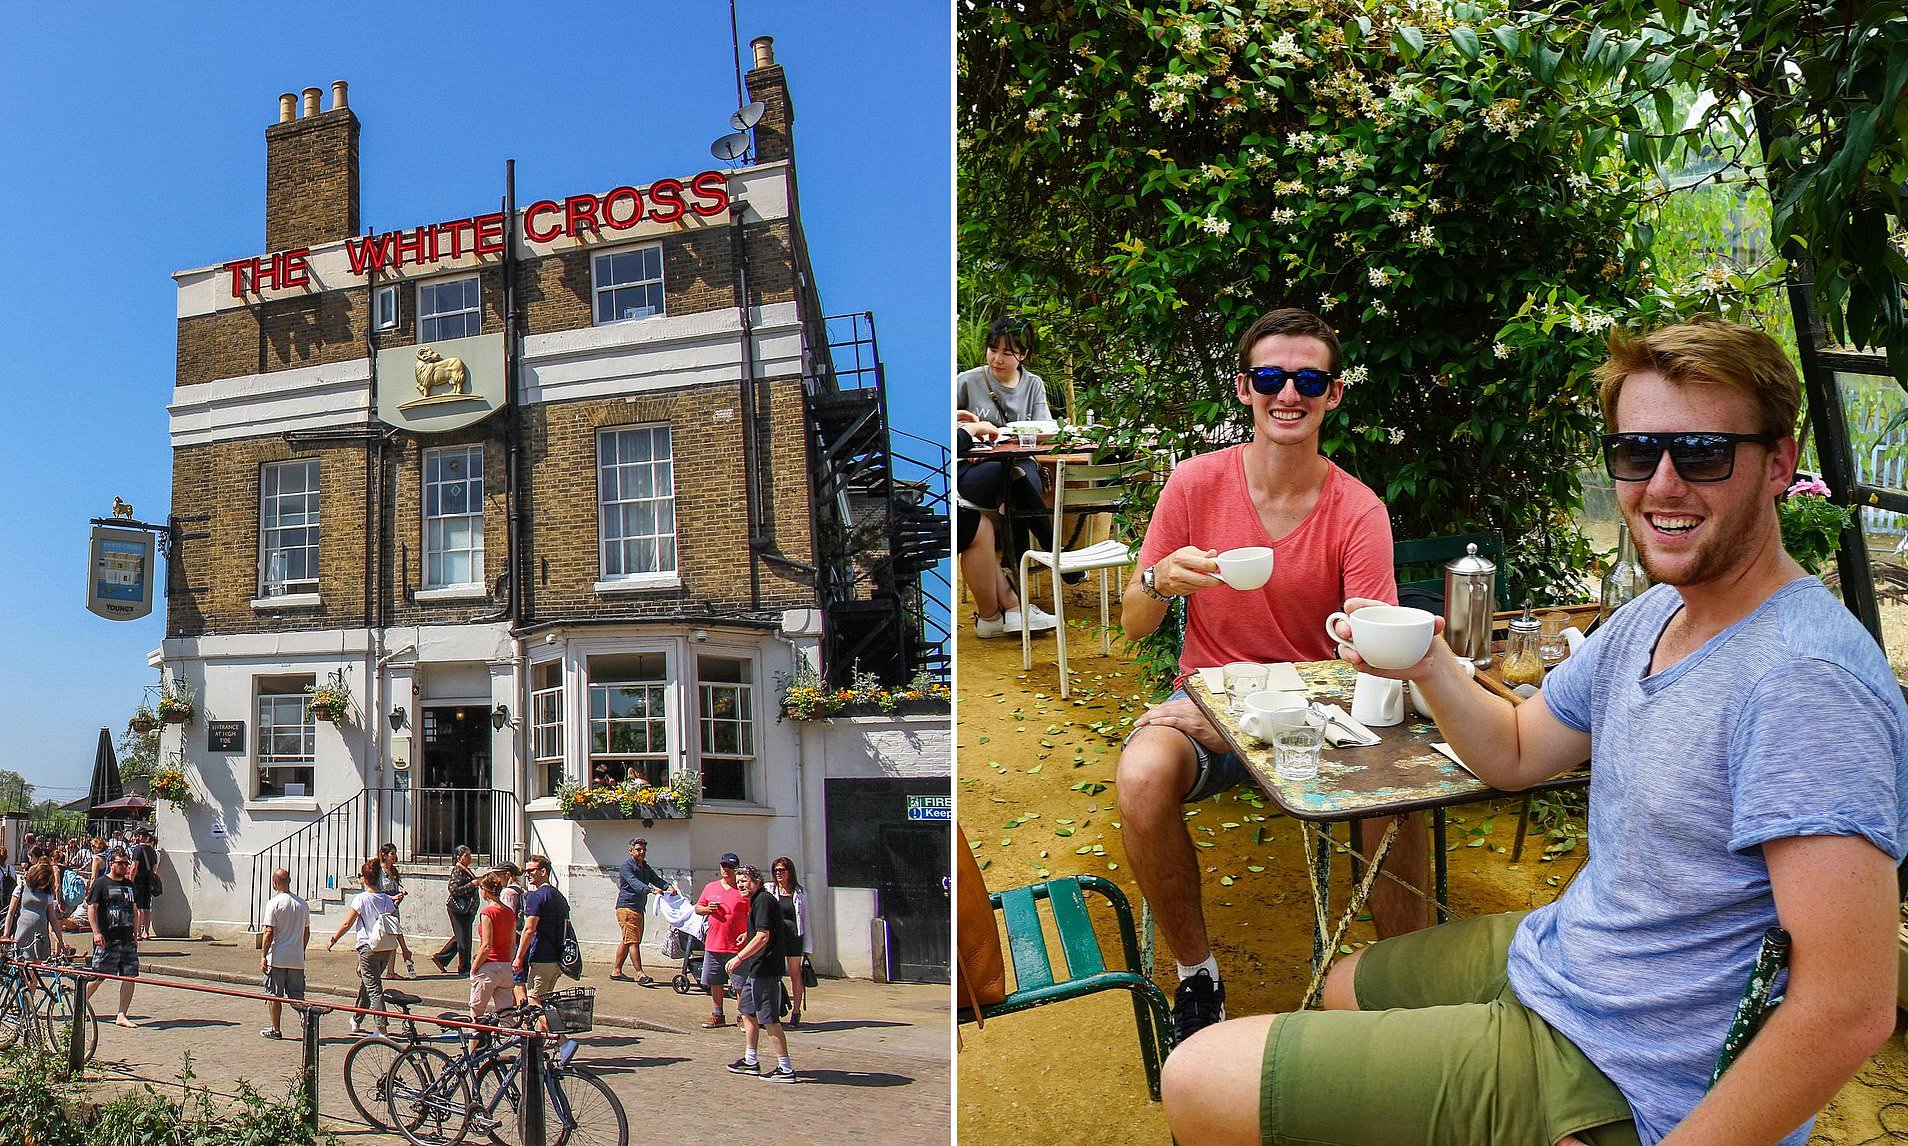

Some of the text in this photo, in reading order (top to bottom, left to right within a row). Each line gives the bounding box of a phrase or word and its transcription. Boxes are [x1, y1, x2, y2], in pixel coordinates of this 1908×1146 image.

[223, 171, 728, 298] THE WHITE CROSS
[925, 797, 951, 806] FIRE
